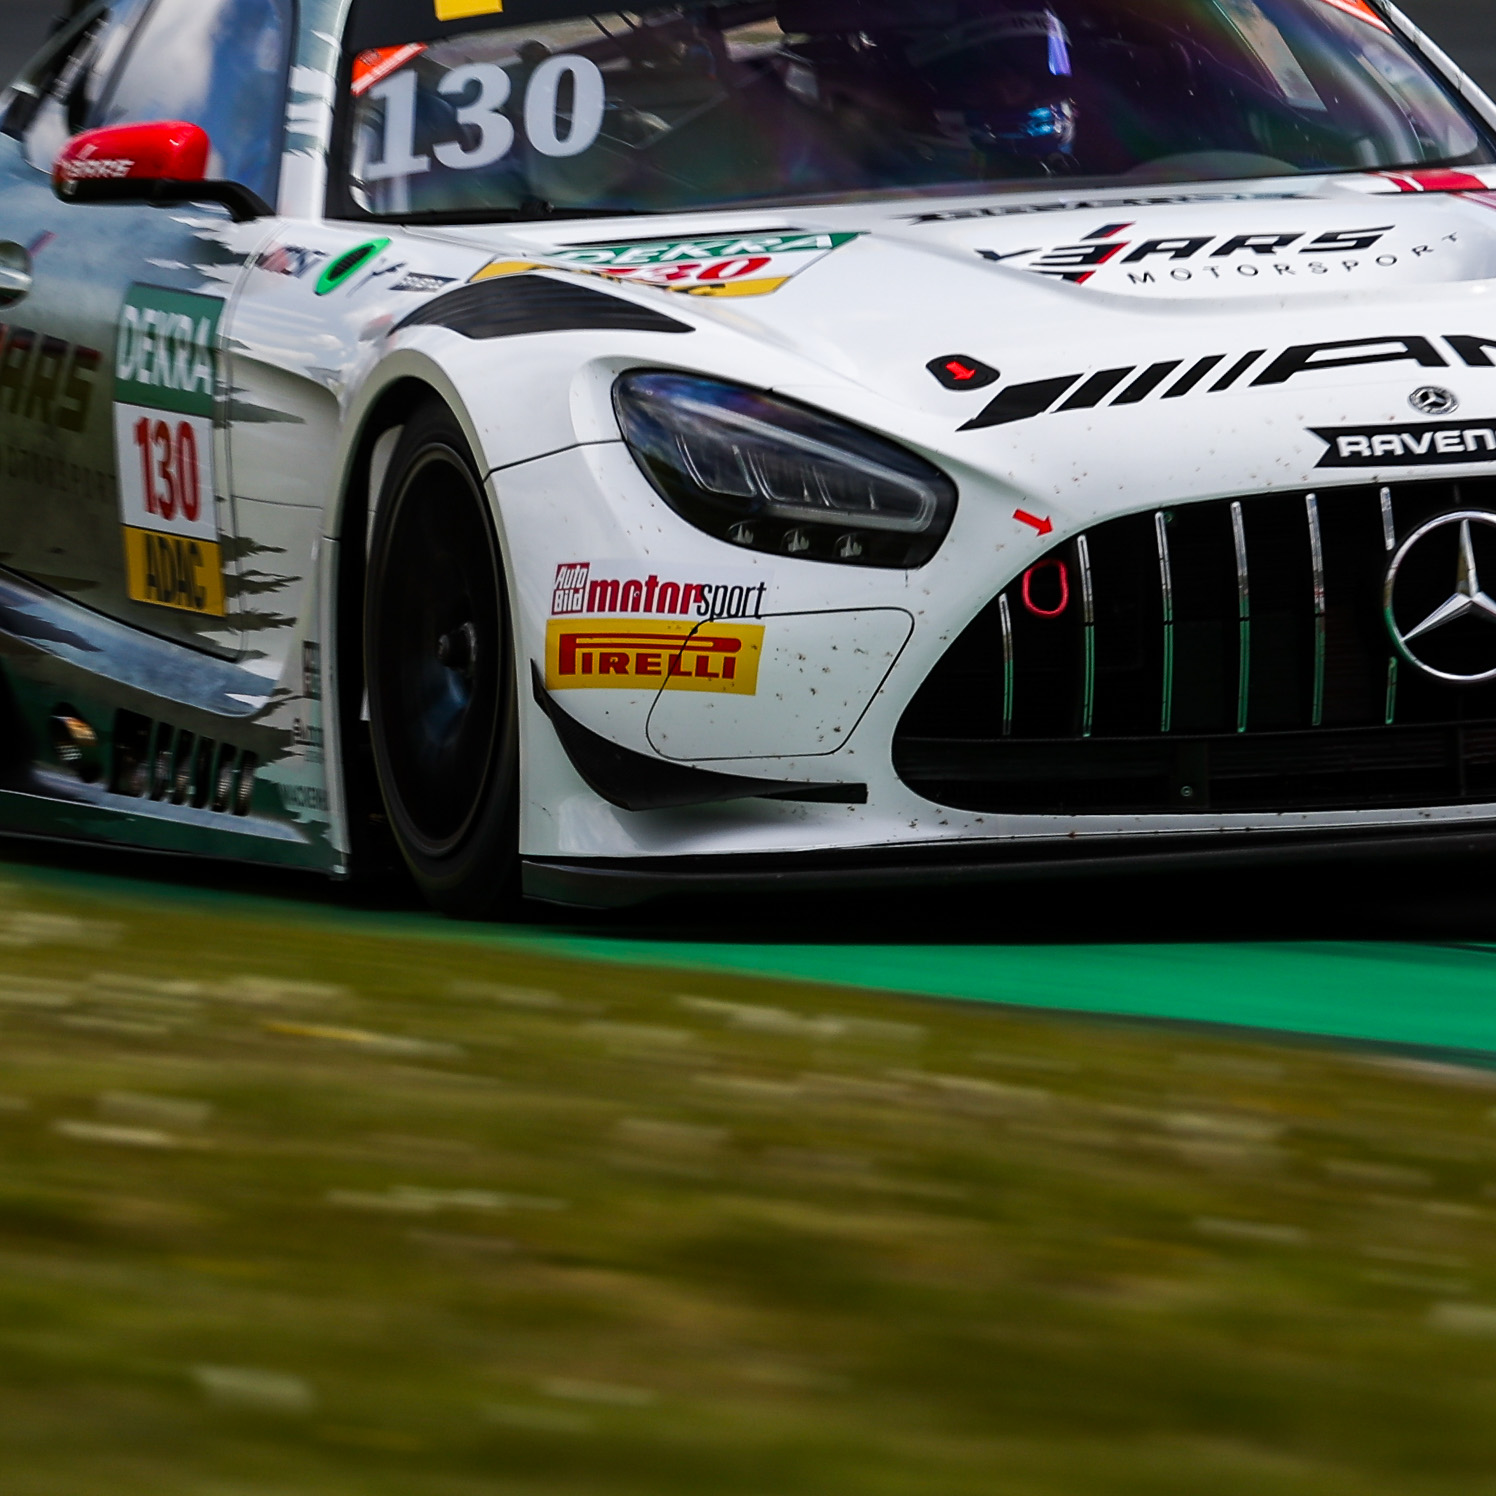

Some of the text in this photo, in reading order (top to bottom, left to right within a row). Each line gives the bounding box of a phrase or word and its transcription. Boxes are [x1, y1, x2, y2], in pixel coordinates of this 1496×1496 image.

[363, 54, 605, 181] 130
[553, 234, 834, 265] DEKRA
[1125, 231, 1460, 286] MOTORSPORT
[116, 304, 213, 395] DEKRA
[135, 416, 200, 522] 130
[144, 534, 207, 610] ADAC
[554, 564, 589, 589] Auto
[554, 588, 584, 613] Bild
[558, 633, 742, 680] PIRELLI
